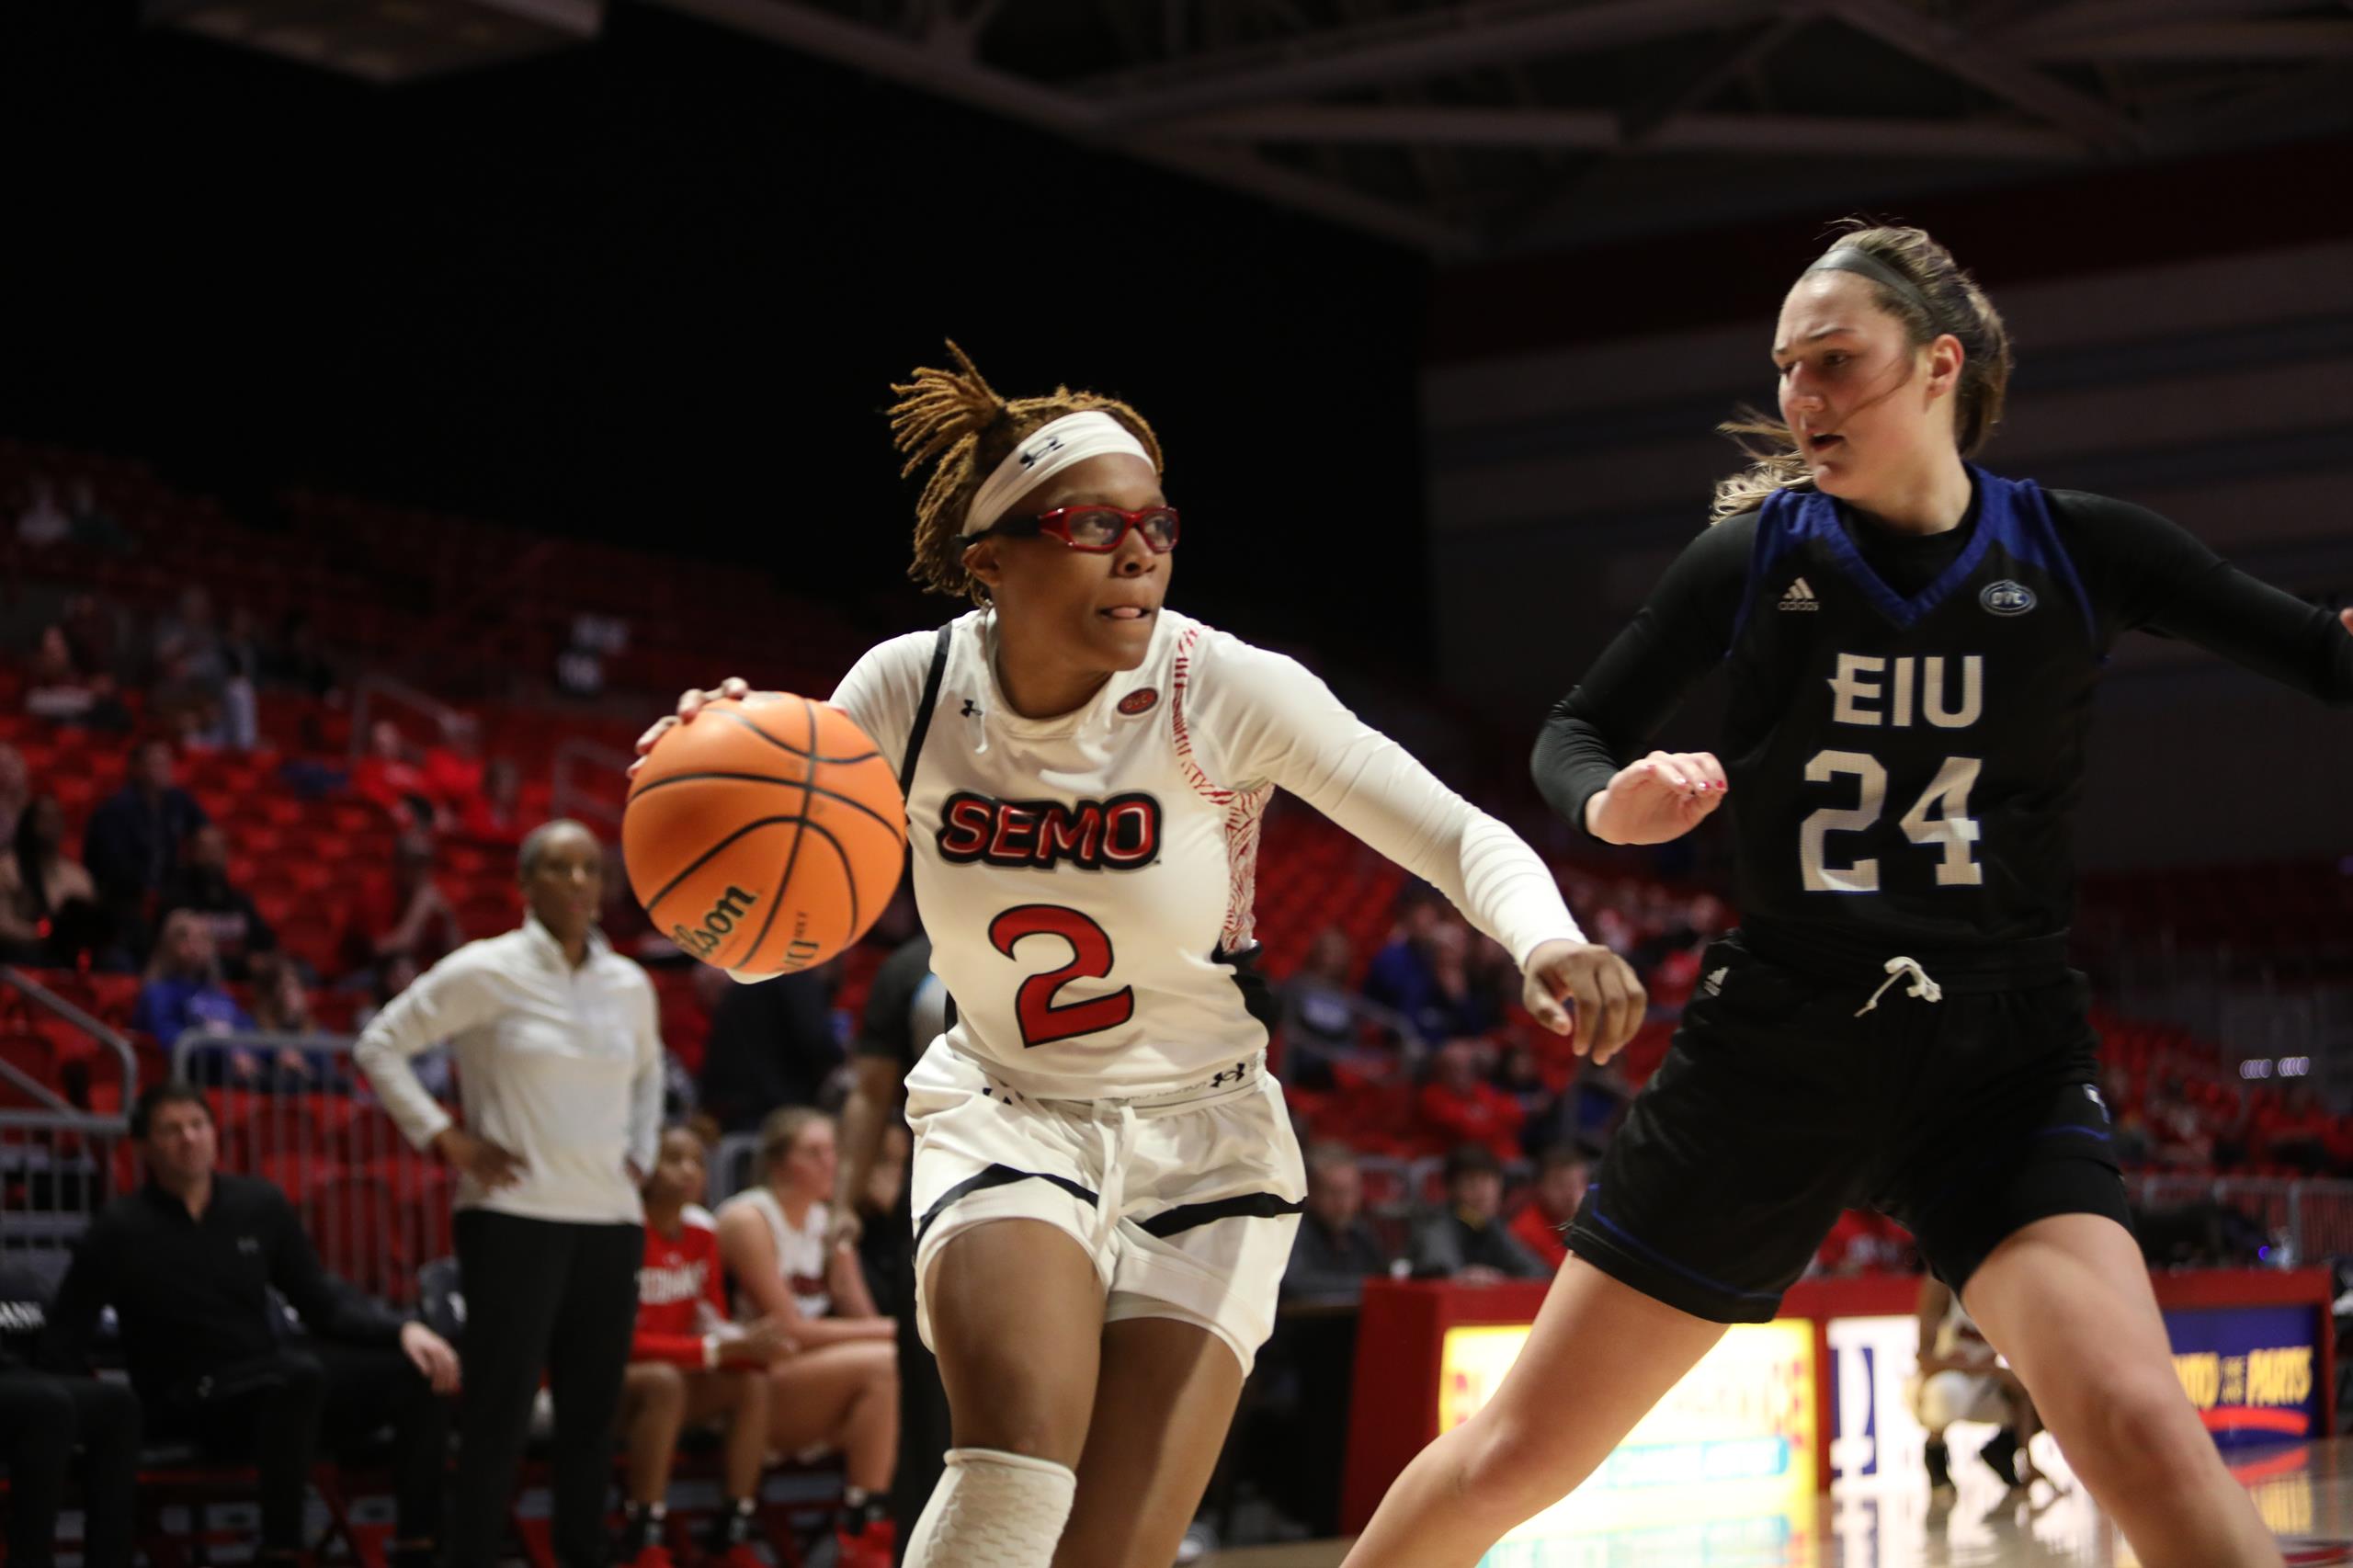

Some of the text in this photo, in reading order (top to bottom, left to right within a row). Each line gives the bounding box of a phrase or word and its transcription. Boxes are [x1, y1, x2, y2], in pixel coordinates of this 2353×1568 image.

[1827, 652, 1984, 728] EIU
[937, 791, 1161, 869] SEMO
[1800, 749, 1983, 892] 24
[988, 903, 1134, 1048] 2
